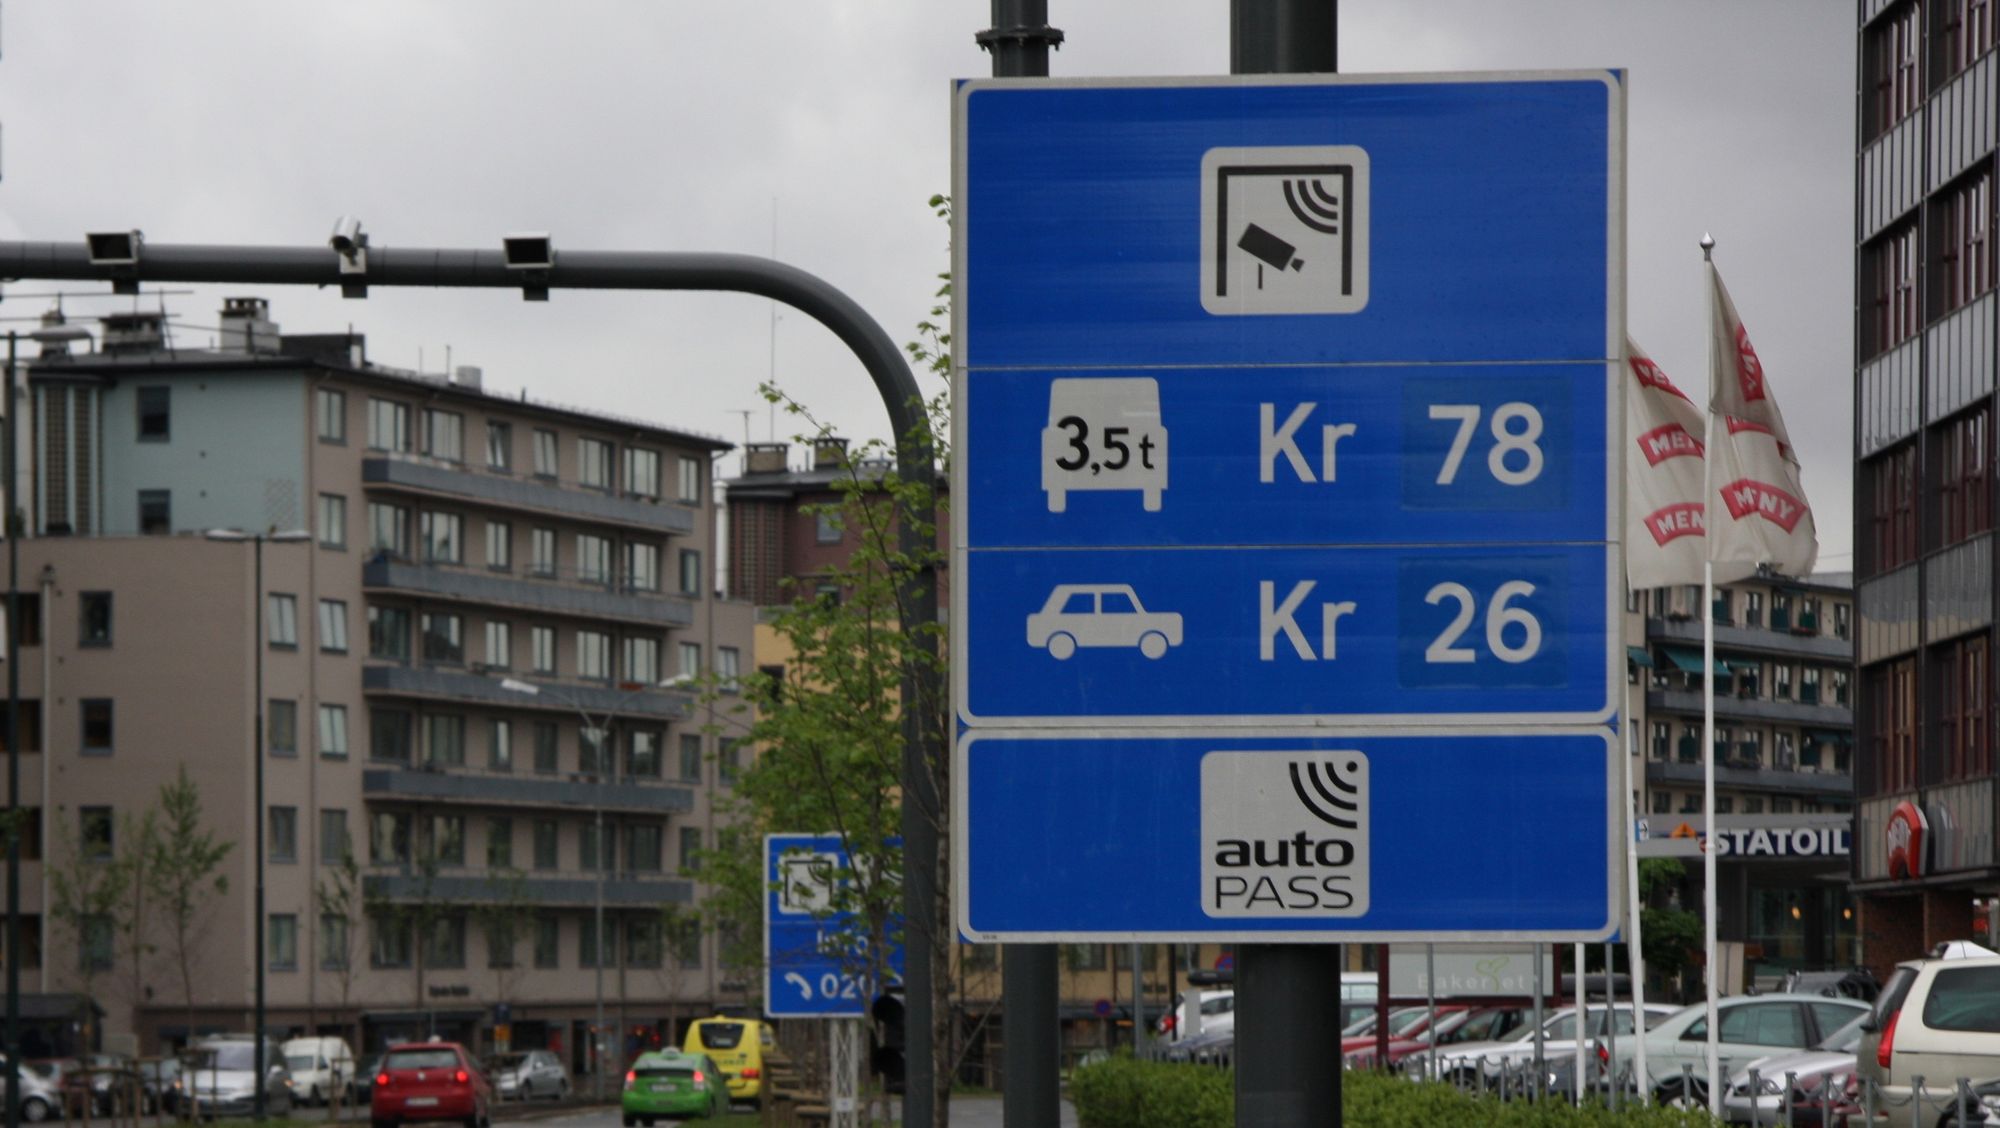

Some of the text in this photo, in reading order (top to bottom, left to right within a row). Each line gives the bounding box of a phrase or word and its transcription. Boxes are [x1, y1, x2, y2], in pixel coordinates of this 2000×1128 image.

[1259, 401, 1545, 486] Kr 78
[1656, 510, 1705, 537] MEN
[1259, 580, 1543, 663] Kr 26
[1214, 831, 1355, 868] auto
[1715, 828, 1850, 855] STATOIL
[1214, 876, 1354, 909] PASS
